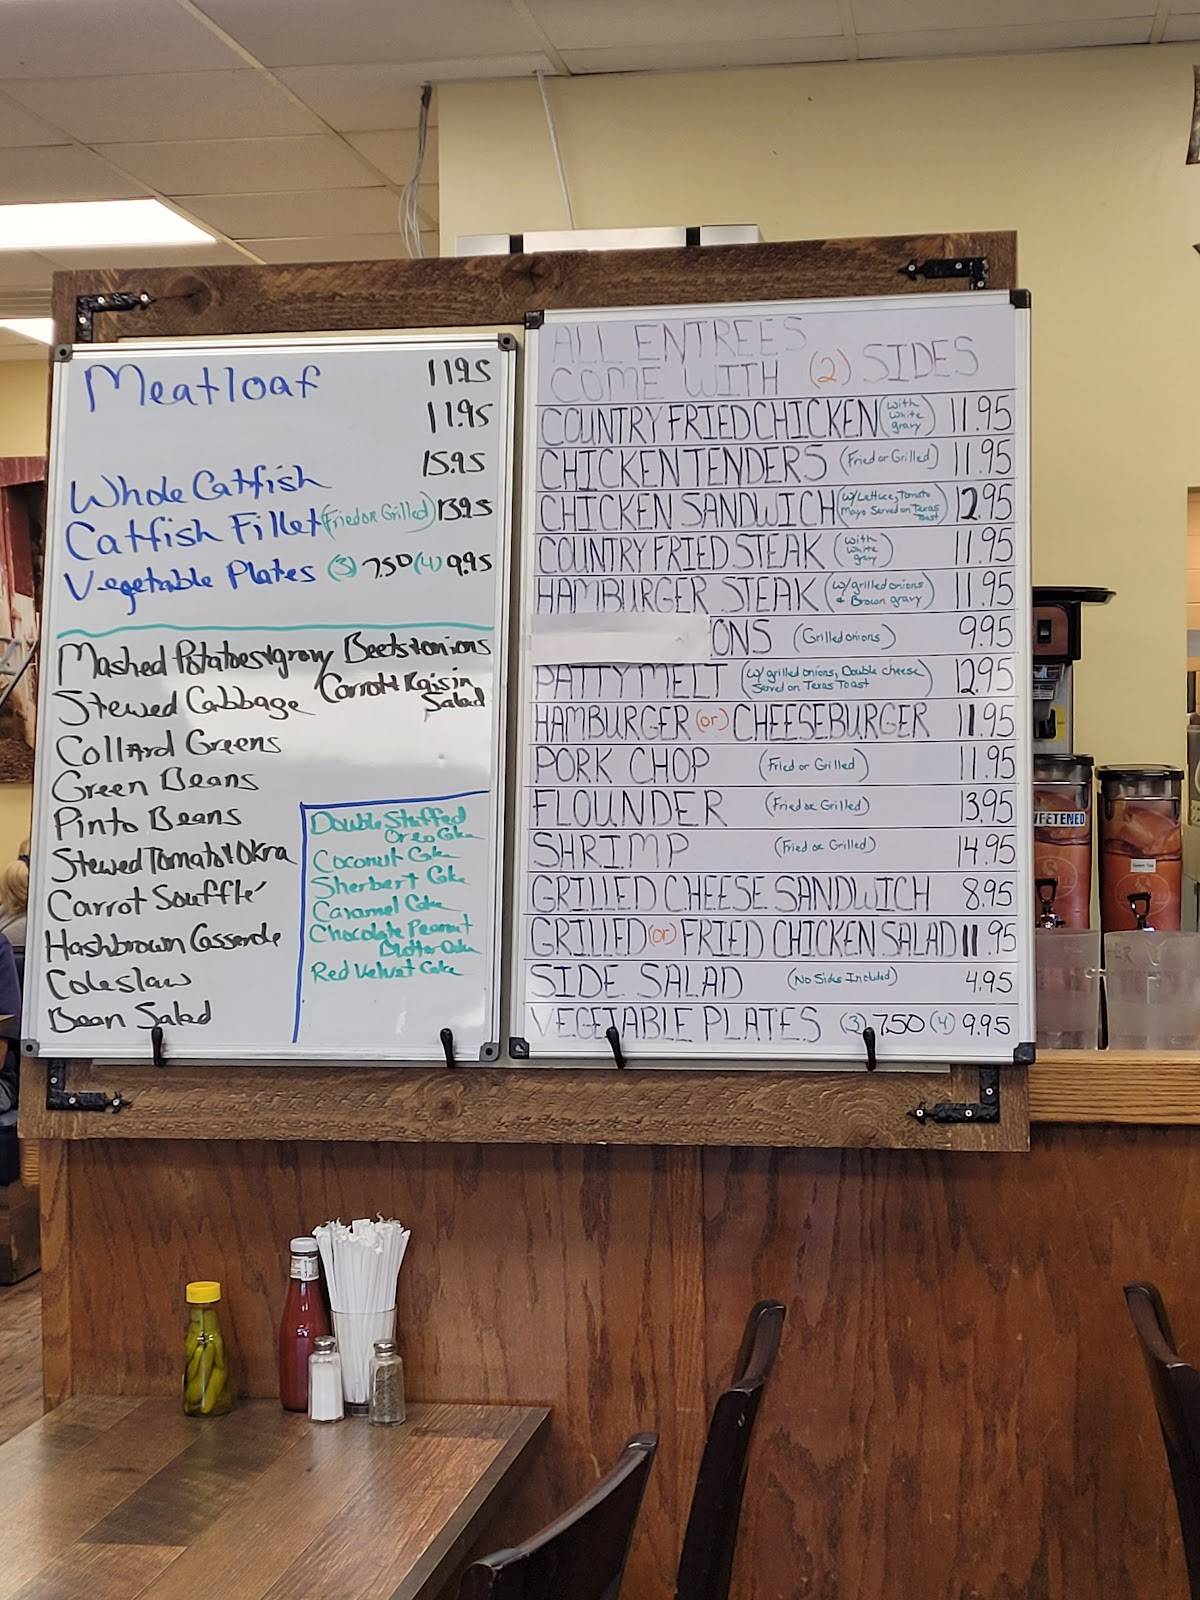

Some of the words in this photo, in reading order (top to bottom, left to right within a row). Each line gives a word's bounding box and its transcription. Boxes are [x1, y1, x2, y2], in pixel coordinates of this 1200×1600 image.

[552, 325, 623, 364] ALL
[634, 317, 807, 364] ENTREES
[84, 364, 321, 412] Meatloaf
[429, 357, 491, 386] 11.95
[551, 366, 665, 403] COME
[683, 360, 778, 398] WITH
[809, 349, 851, 390] (2)
[863, 336, 978, 383] SIDES
[428, 398, 493, 434] 11.95
[541, 406, 660, 446] COUNTRY
[668, 402, 751, 441] FRIED
[754, 398, 877, 440] CHICKEN
[951, 395, 1012, 432] 11.95
[423, 450, 485, 477] 15.95
[540, 449, 680, 492] CHICKEN
[683, 444, 827, 487] TENDERS
[955, 439, 1012, 476] 11.95
[71, 474, 189, 514] Whole
[193, 464, 332, 500] Catfish
[956, 483, 1012, 522] 12.95
[438, 497, 492, 521] 13.95
[540, 493, 672, 531] CHICKEN
[681, 490, 836, 529] SANDWICH
[66, 516, 224, 561] Catfish
[230, 508, 322, 544] Fillet
[539, 536, 646, 574] COUNTRY
[653, 535, 728, 571] FRIED
[733, 532, 825, 570] STEAK
[955, 527, 1013, 565] 11.95
[328, 554, 357, 582] (3)
[362, 553, 413, 579] 7.50
[414, 552, 442, 575] (4)
[447, 552, 492, 576] 9.95
[64, 566, 214, 615] Vegetable
[227, 558, 316, 590] Plates
[537, 576, 709, 614] HAMBURGER
[721, 576, 817, 613] STEAK
[956, 571, 1013, 609] 11.95
[959, 615, 1013, 649] 9.95
[58, 642, 168, 686] Mashed
[535, 665, 632, 700] PATTY
[637, 663, 728, 698] MELT
[955, 657, 1014, 695] 12.95
[52, 690, 178, 726] Stewed
[186, 685, 316, 720] Cabbage
[421, 688, 485, 712] Salad
[535, 705, 691, 742] HAMBURGER
[696, 708, 730, 733] (or)
[733, 702, 930, 741] CHEESEBURGER
[958, 702, 1014, 738] 11.95
[57, 730, 175, 766] Collard
[186, 729, 282, 755] Greens
[535, 746, 612, 784] PORK
[629, 746, 710, 783] CHOP
[960, 745, 1015, 780] 11.95
[52, 769, 149, 803] Green
[160, 766, 259, 791] Beans
[800, 763, 809, 771] or
[54, 806, 139, 841] Pinto
[149, 805, 241, 831] Beans
[311, 811, 382, 835] Double
[533, 789, 727, 827] FLOUNDER
[960, 789, 1013, 823] 13.95
[1034, 813, 1085, 825] EETENED
[384, 829, 435, 843] Oreo
[533, 832, 689, 869] SHRIMP
[958, 833, 1015, 868] 14.95
[51, 848, 142, 882] Stewed
[313, 847, 403, 873] Coconut
[48, 886, 147, 921] Carrot
[311, 873, 419, 899] Sherbert
[532, 874, 657, 912] GRILLED
[665, 874, 767, 912] CHEESE
[774, 875, 930, 912] SANDWICH
[962, 877, 1013, 911] 8.95
[312, 895, 399, 922] Caramel
[45, 929, 186, 963] Hashbrown
[190, 923, 281, 953] Casserole
[309, 921, 404, 943] Chocolate
[408, 914, 473, 938] Peanut
[531, 917, 646, 957] GRILLED
[647, 922, 677, 945] (or)
[681, 918, 764, 957] FRIED
[773, 918, 876, 958] CHICKEN
[882, 921, 957, 957] SALAD
[962, 920, 1017, 957] 11.95
[46, 967, 192, 1000] Coleslaw
[312, 959, 350, 983] Red
[354, 958, 415, 980] Velvet
[419, 959, 464, 976] Cake
[530, 964, 624, 998] SIDE
[637, 963, 743, 998] SALAD
[965, 971, 1013, 994] 4.95
[48, 1006, 126, 1033] Bean
[135, 1000, 211, 1029] Salad
[530, 1007, 693, 1041] VEGETABLE
[703, 1006, 821, 1042] PLATES
[929, 1010, 956, 1035] (4)
[962, 1013, 1011, 1037] 9.95
